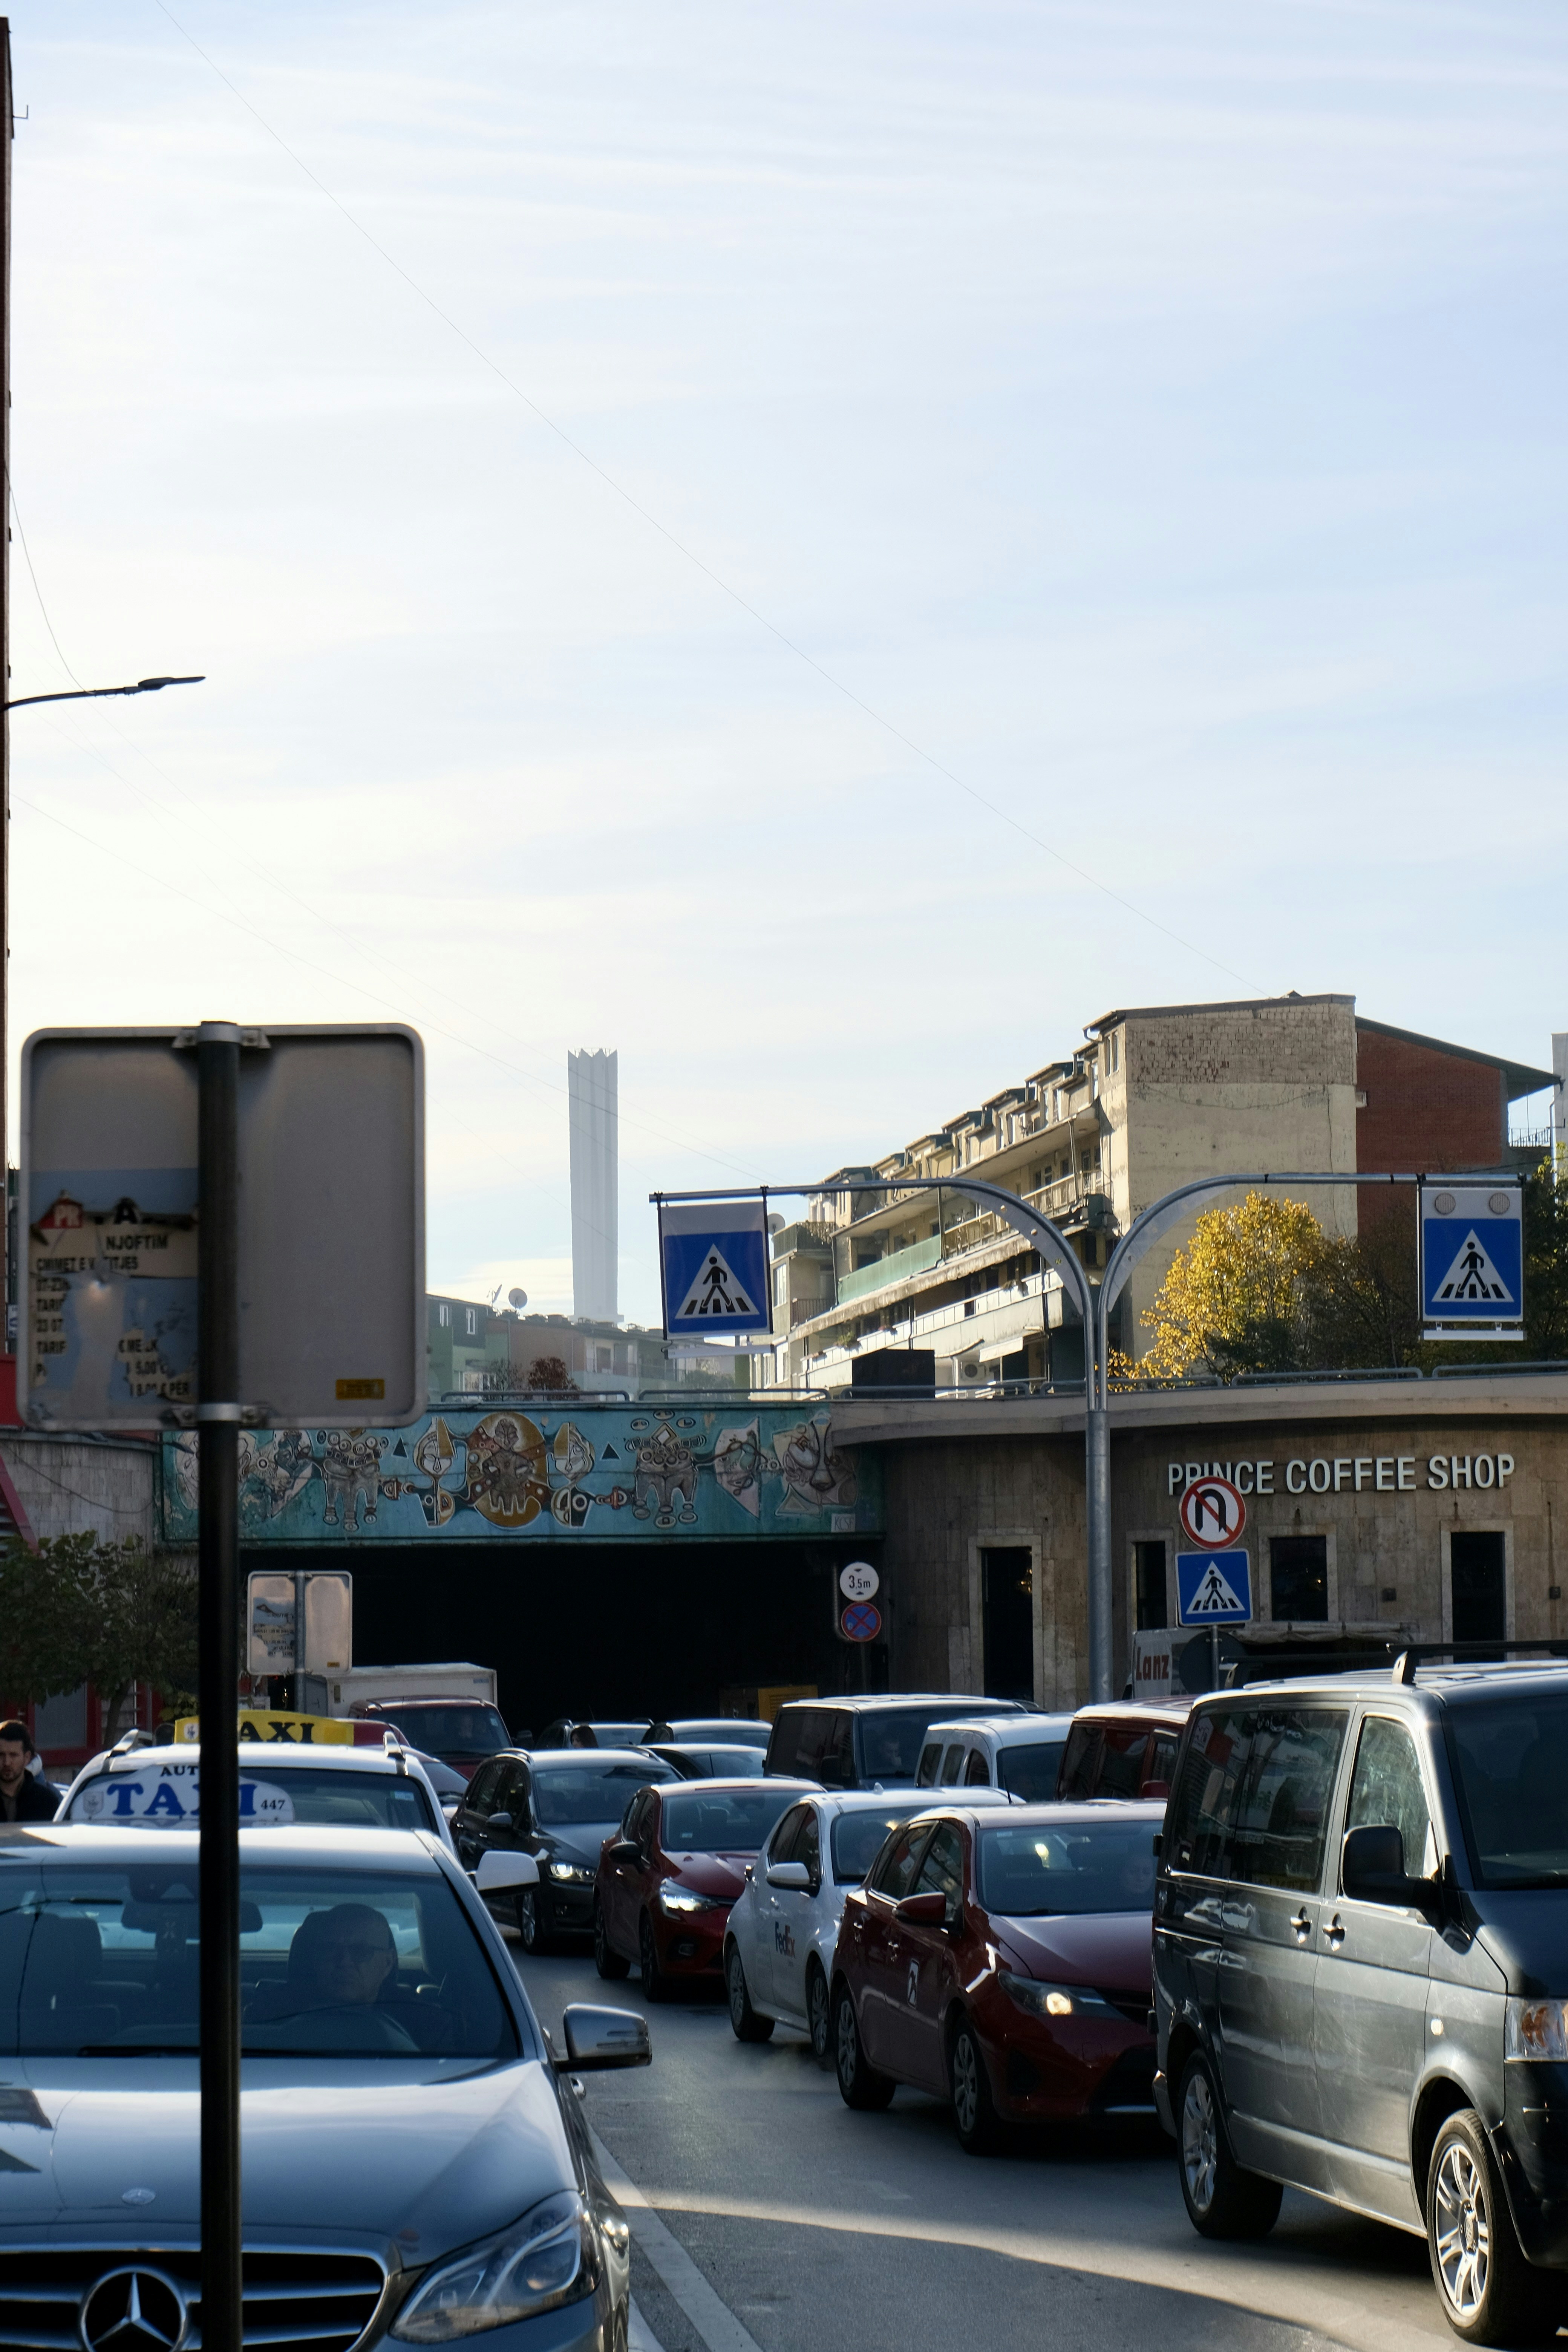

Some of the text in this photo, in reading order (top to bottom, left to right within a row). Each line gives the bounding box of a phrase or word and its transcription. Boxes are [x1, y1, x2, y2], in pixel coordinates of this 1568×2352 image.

[1286, 1456, 1416, 1493] COFFEE
[1428, 1454, 1515, 1490] SHOP
[1136, 1646, 1170, 1681] Lanz
[240, 1721, 314, 1744] AXI
[160, 1766, 199, 1777] AUT
[107, 1783, 285, 1816] TAI 447
[775, 1921, 796, 1959] FedEx
